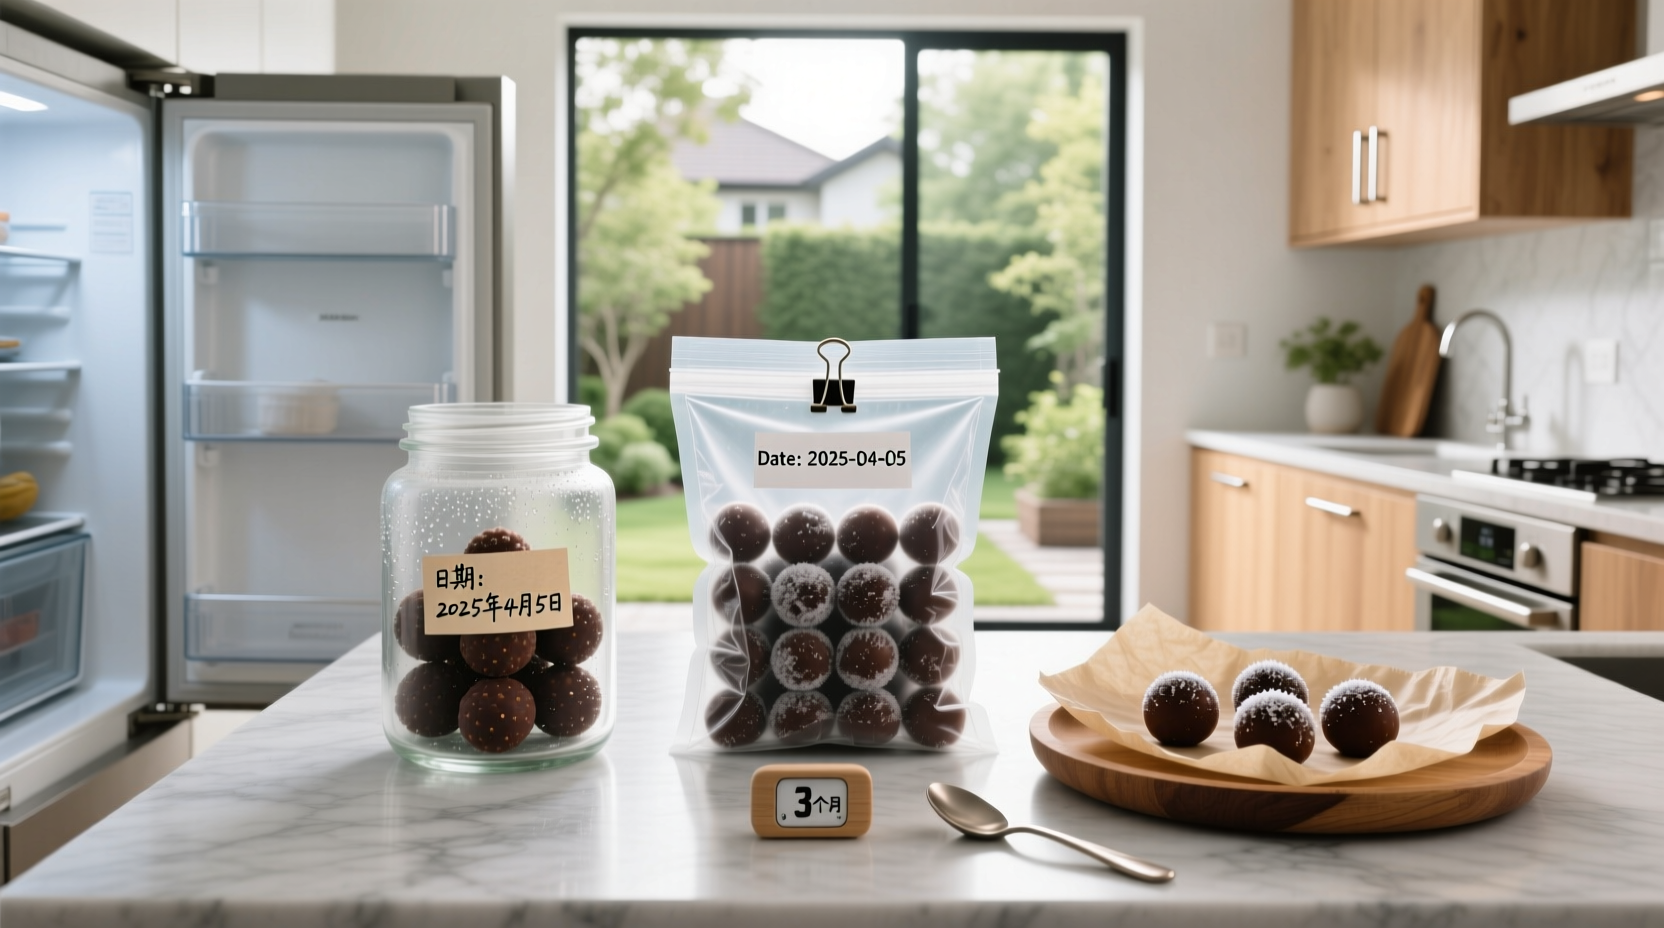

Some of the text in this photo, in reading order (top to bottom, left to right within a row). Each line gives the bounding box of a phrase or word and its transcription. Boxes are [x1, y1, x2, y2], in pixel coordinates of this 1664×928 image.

[758, 450, 906, 466] Date: 2025-04-05
[436, 563, 483, 591] 日期：
[436, 592, 561, 623] 2025年4月5日
[794, 786, 841, 818] 3个月
